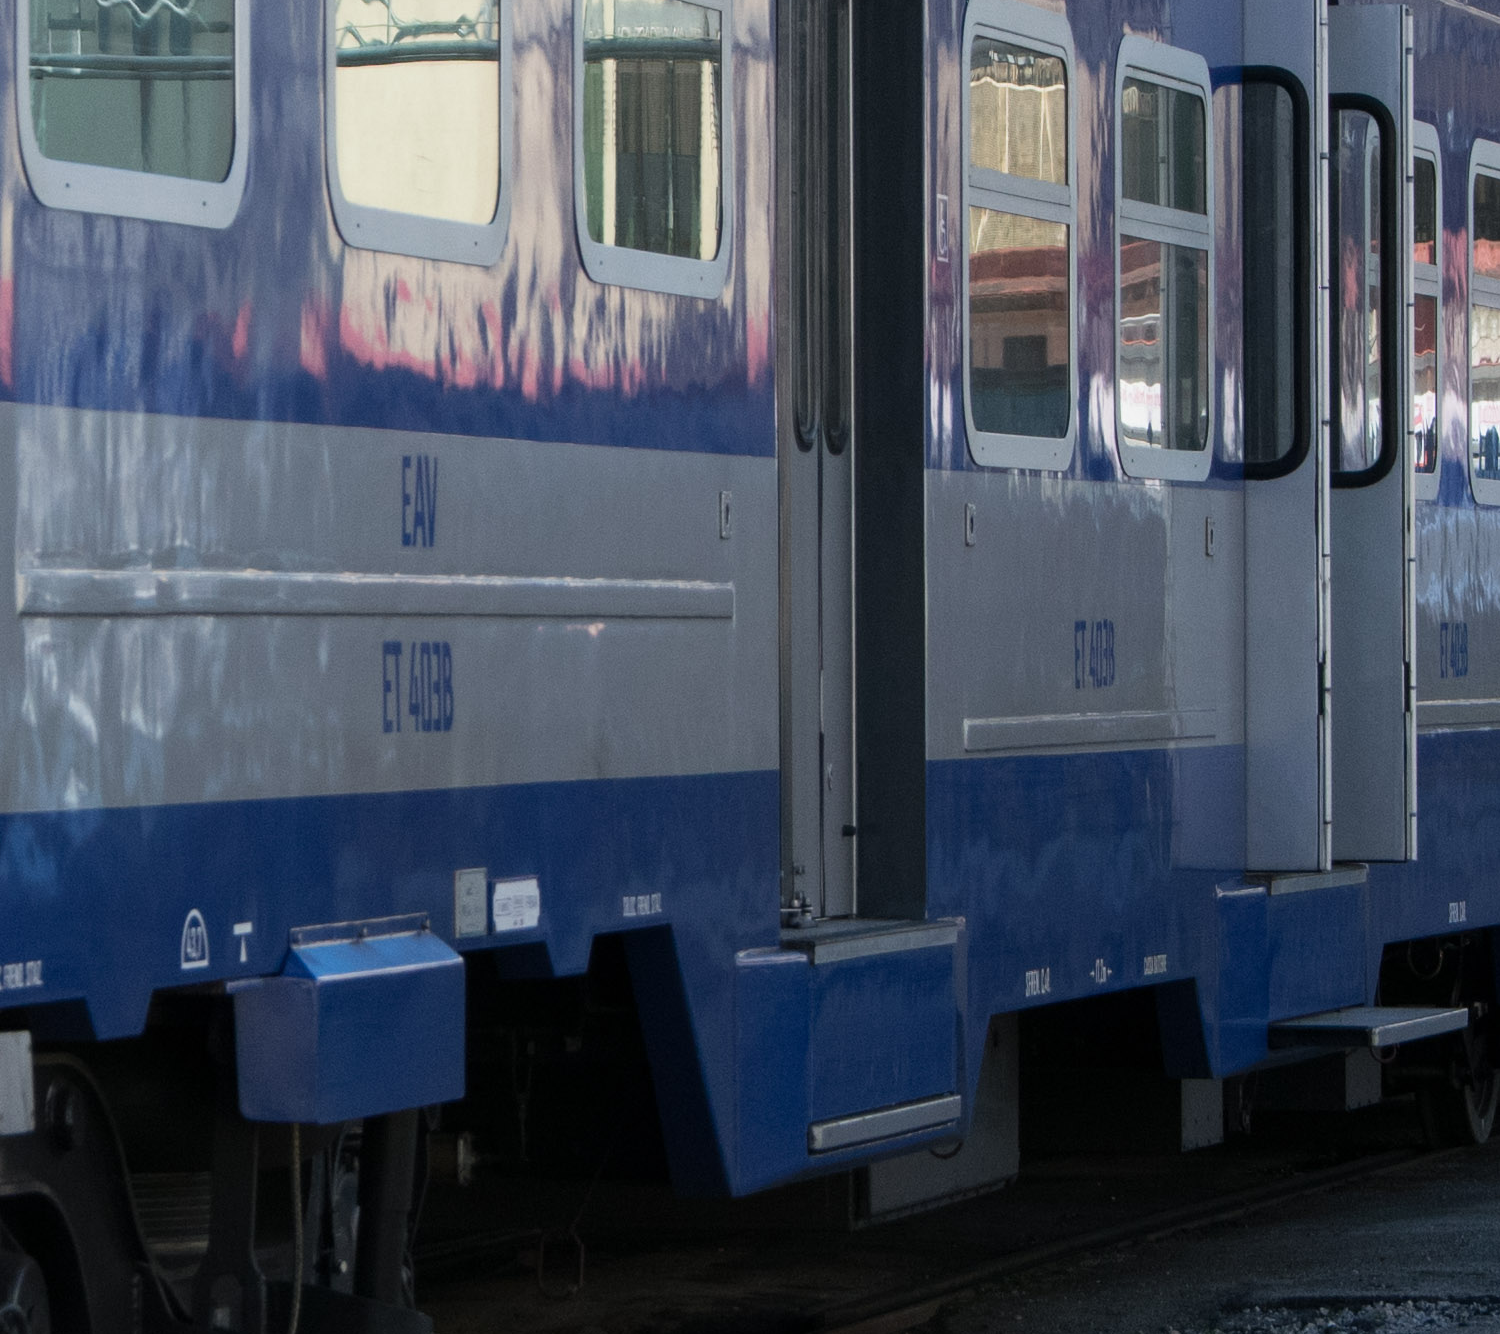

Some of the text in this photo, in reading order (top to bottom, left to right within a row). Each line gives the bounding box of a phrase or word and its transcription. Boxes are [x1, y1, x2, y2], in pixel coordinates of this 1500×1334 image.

[401, 455, 438, 548] EAV
[382, 640, 455, 734] ET 403B
[1074, 619, 1087, 689] ET
